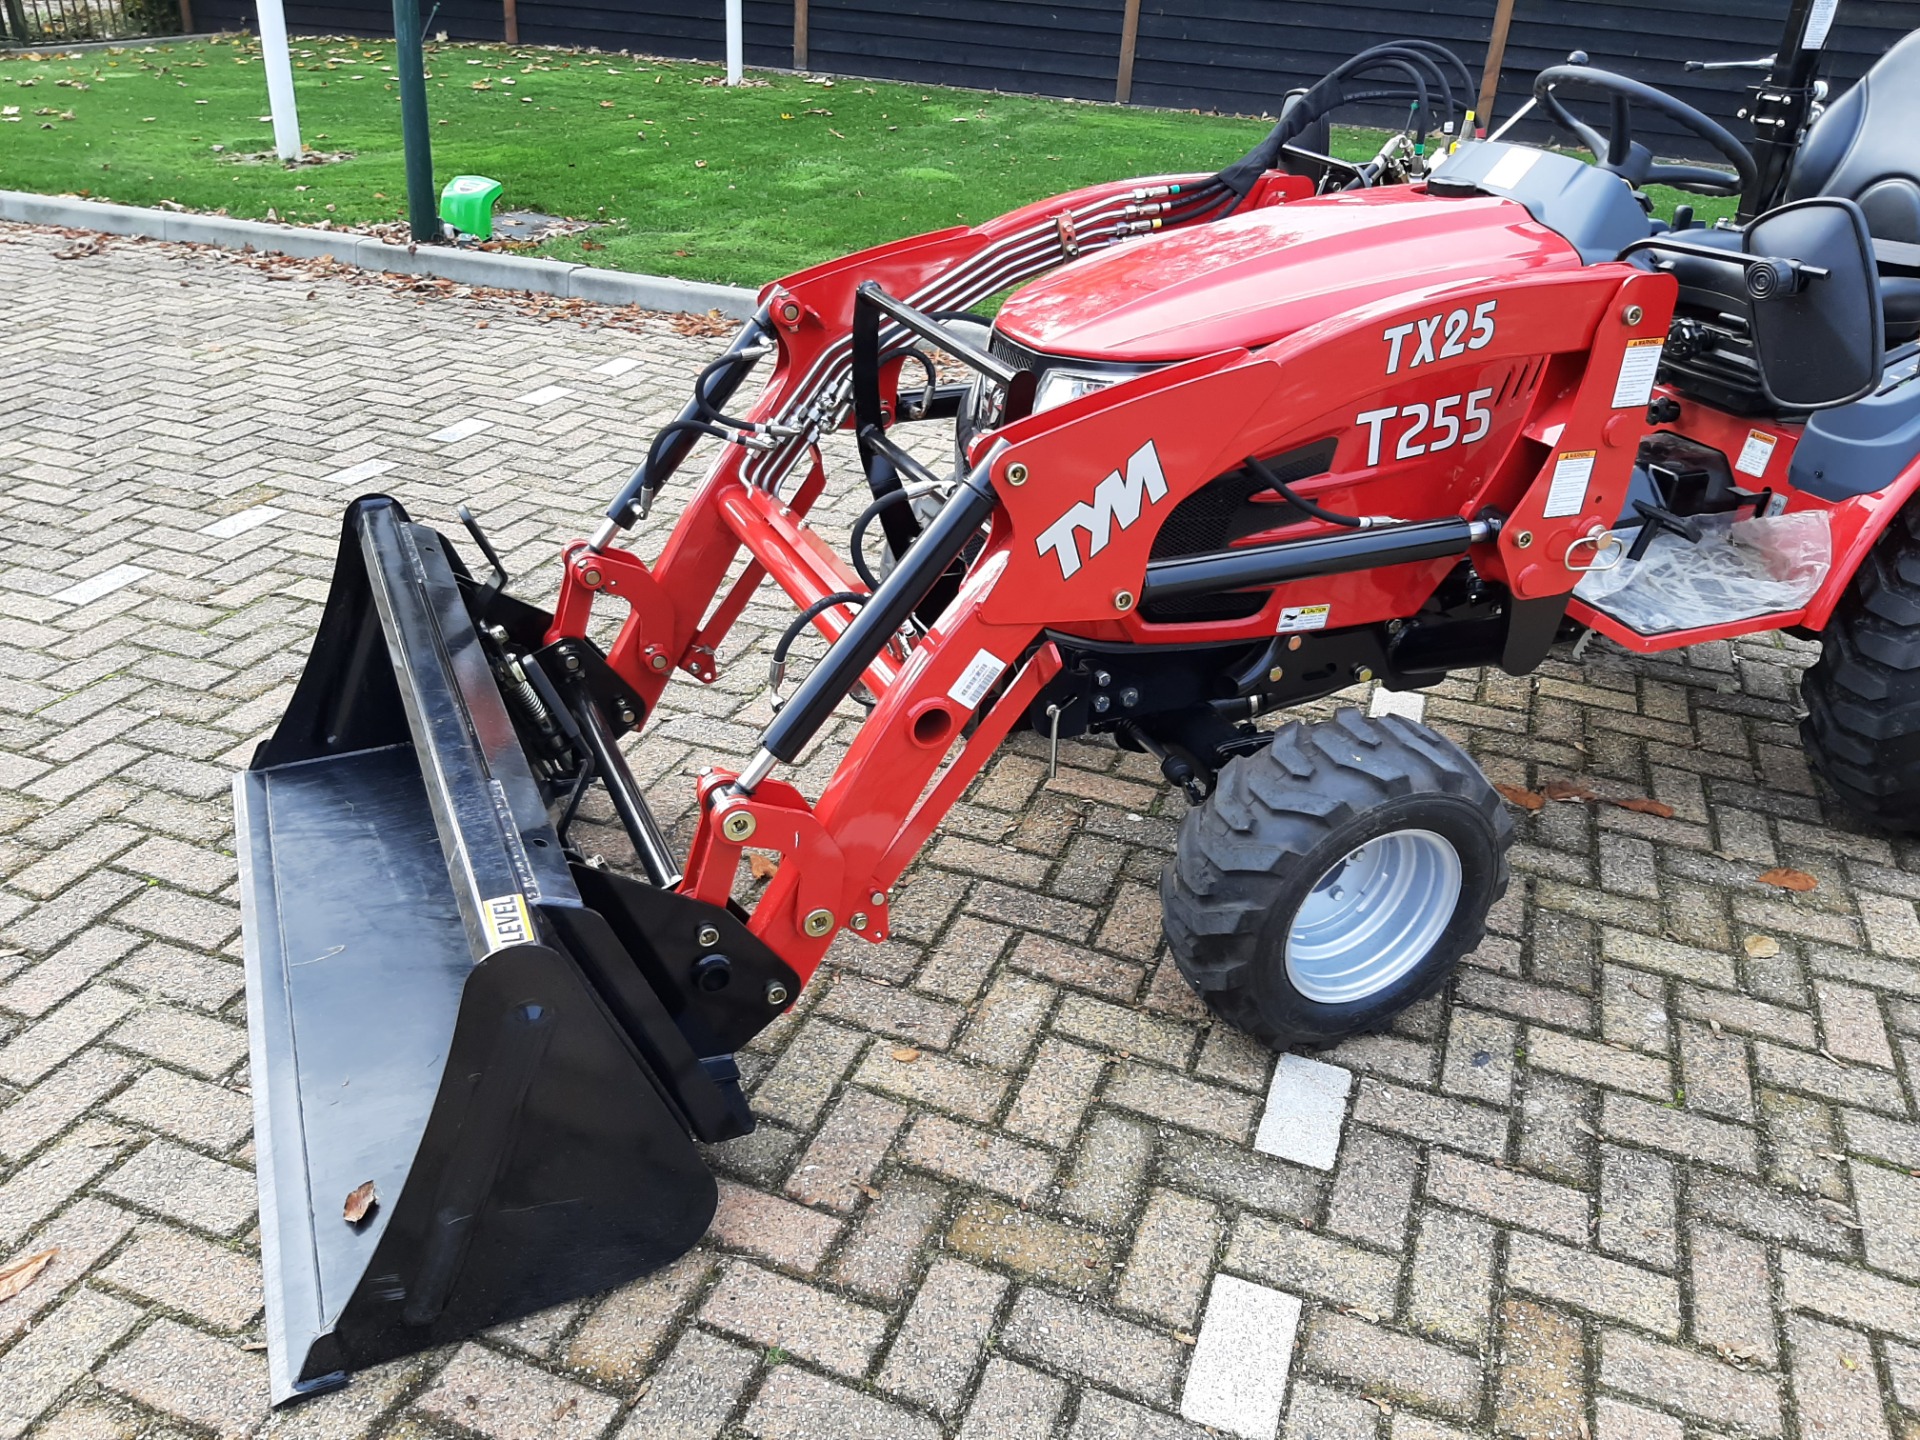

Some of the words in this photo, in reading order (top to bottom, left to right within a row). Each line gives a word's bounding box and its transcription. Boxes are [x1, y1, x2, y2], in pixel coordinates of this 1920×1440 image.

[1382, 299, 1497, 375] TX25
[1355, 387, 1493, 467] T255
[1035, 438, 1169, 581] TYM
[492, 896, 525, 943] LEVEL
